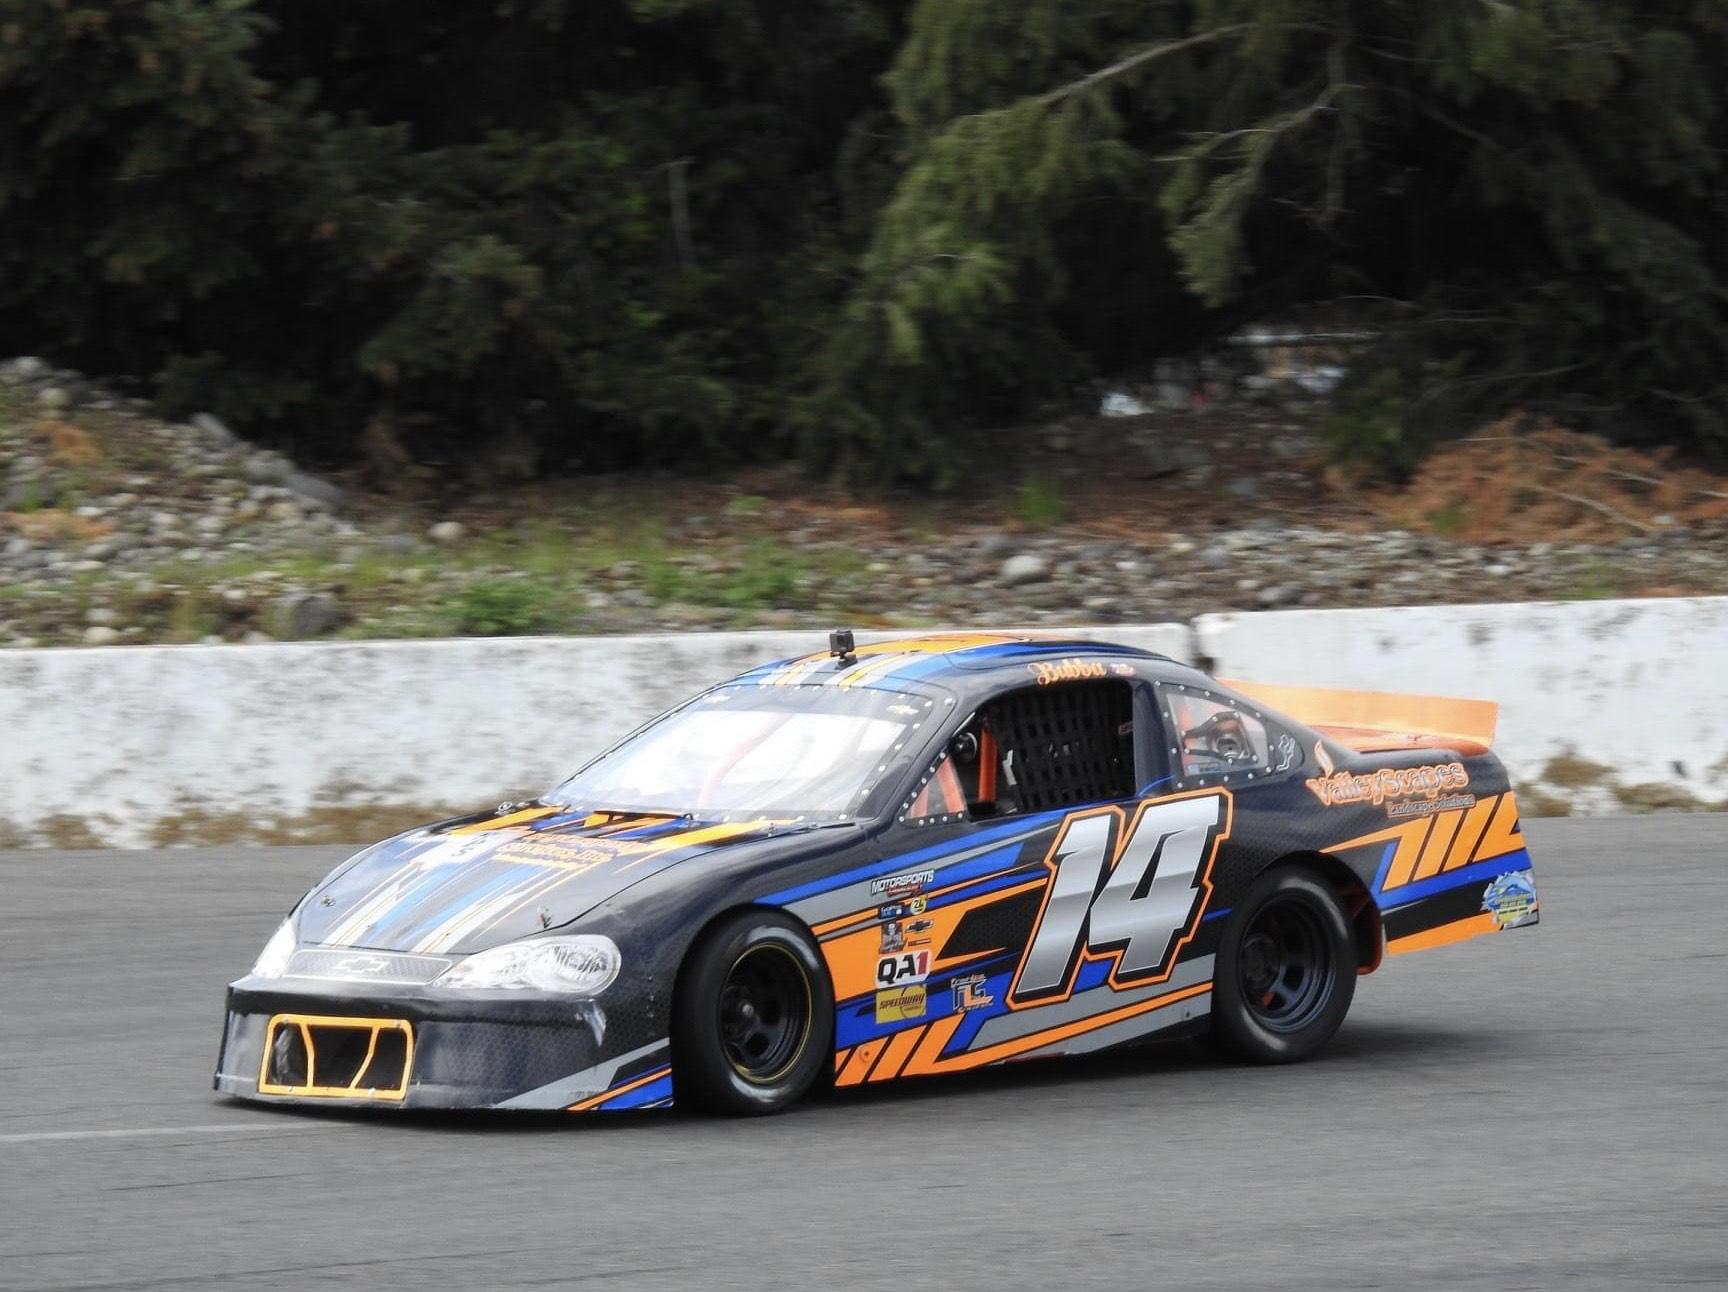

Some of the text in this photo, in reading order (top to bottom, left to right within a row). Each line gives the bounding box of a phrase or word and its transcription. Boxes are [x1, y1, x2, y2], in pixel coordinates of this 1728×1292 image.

[871, 870, 934, 895] MOTORSPORTS
[1009, 789, 1226, 1006] 14
[877, 951, 929, 984] QA1
[879, 992, 926, 1010] SPEEDWAY
